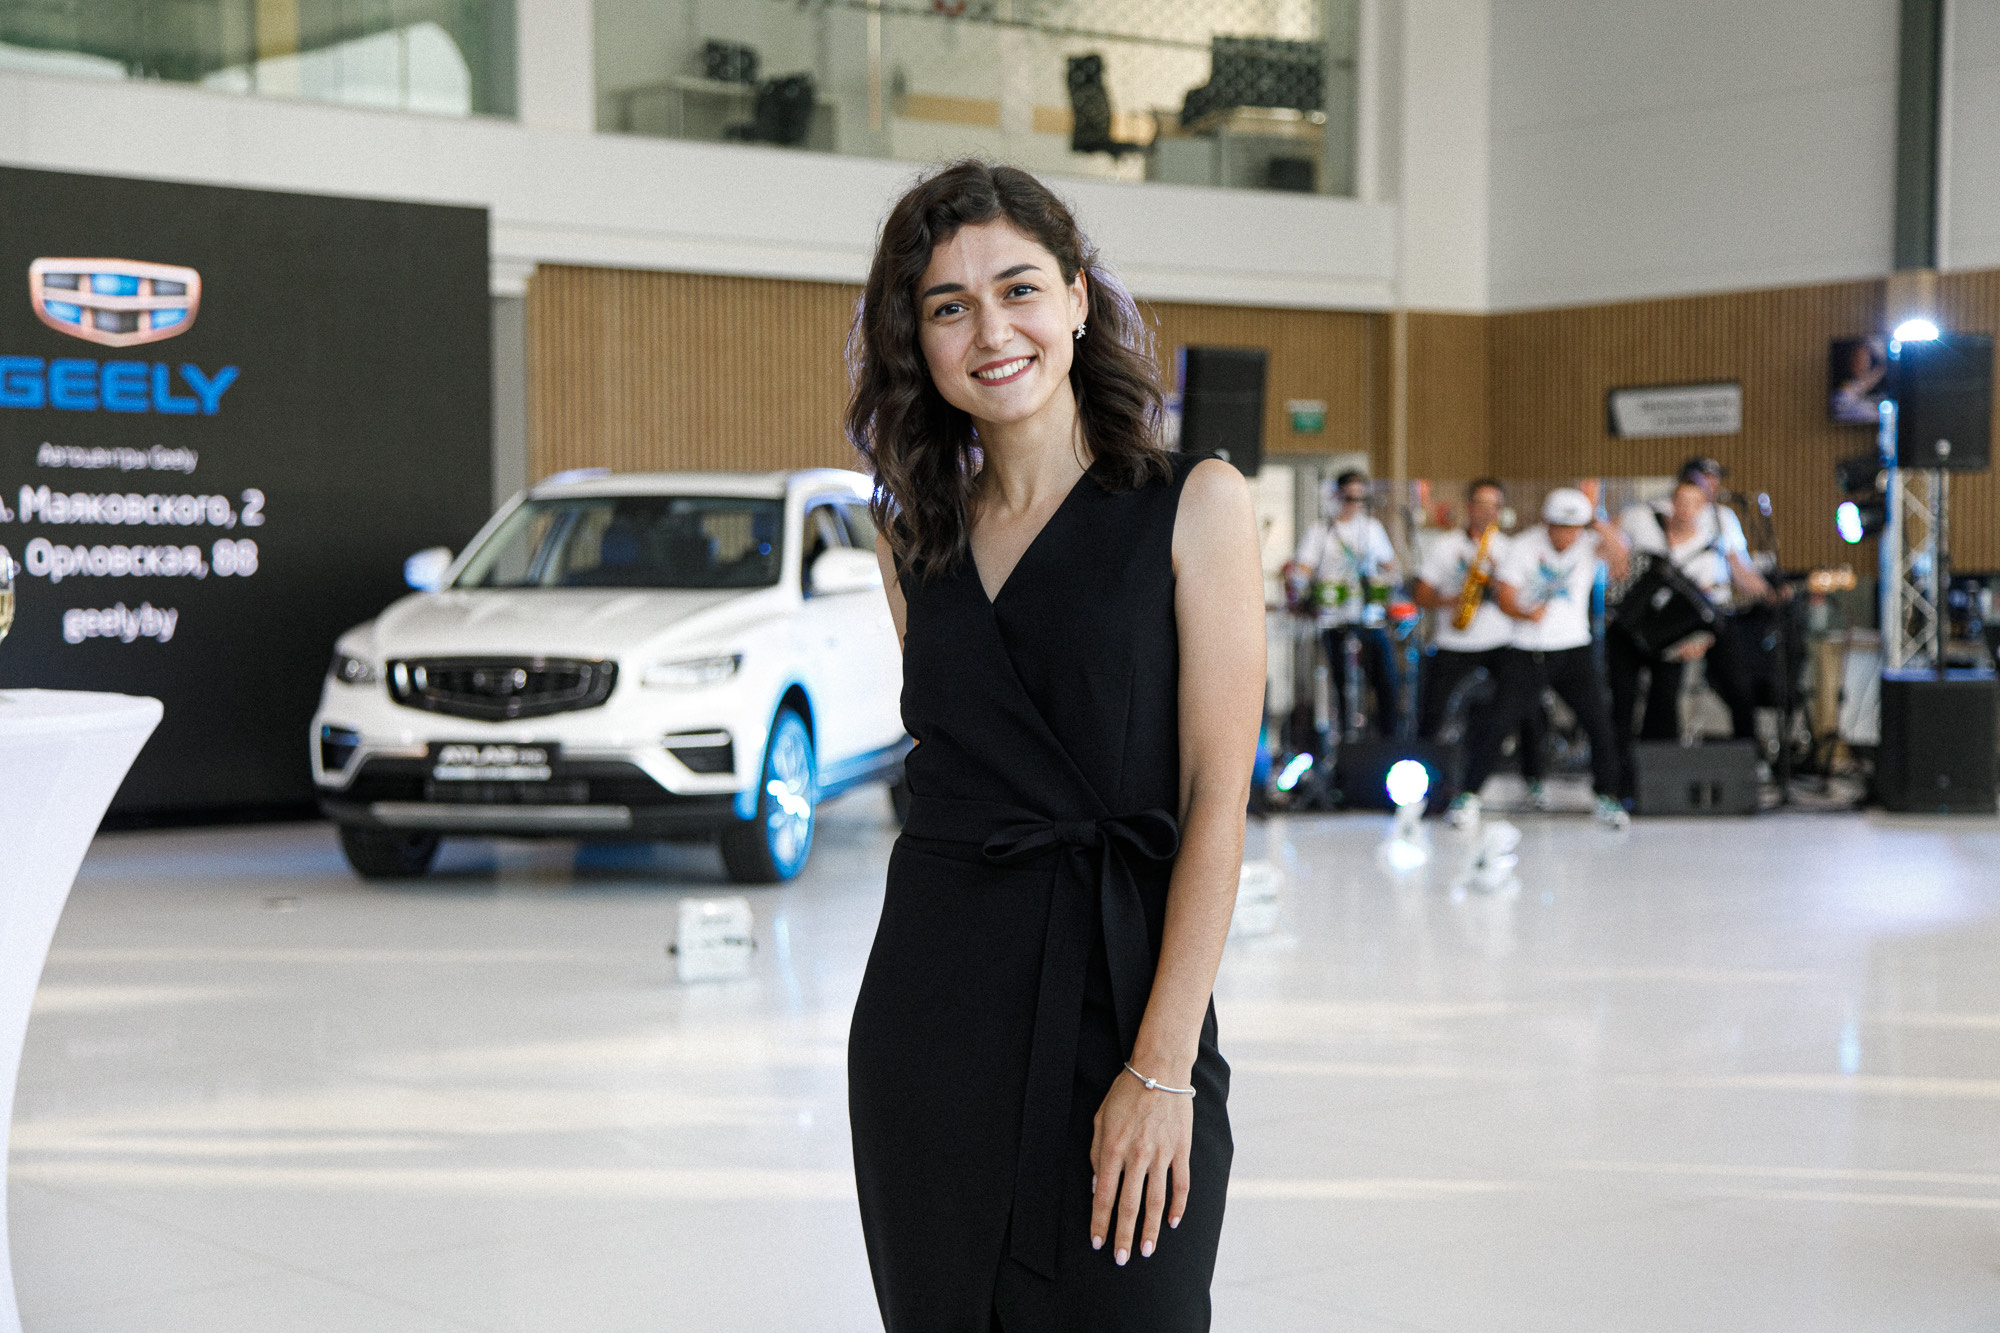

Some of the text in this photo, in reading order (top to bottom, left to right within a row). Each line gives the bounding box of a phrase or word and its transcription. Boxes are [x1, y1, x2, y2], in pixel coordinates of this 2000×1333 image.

[0, 356, 240, 415] GEELY
[19, 485, 237, 529] Маяковского,
[241, 488, 265, 526] 2
[25, 537, 208, 584] Орловская,
[212, 539, 258, 577] 88
